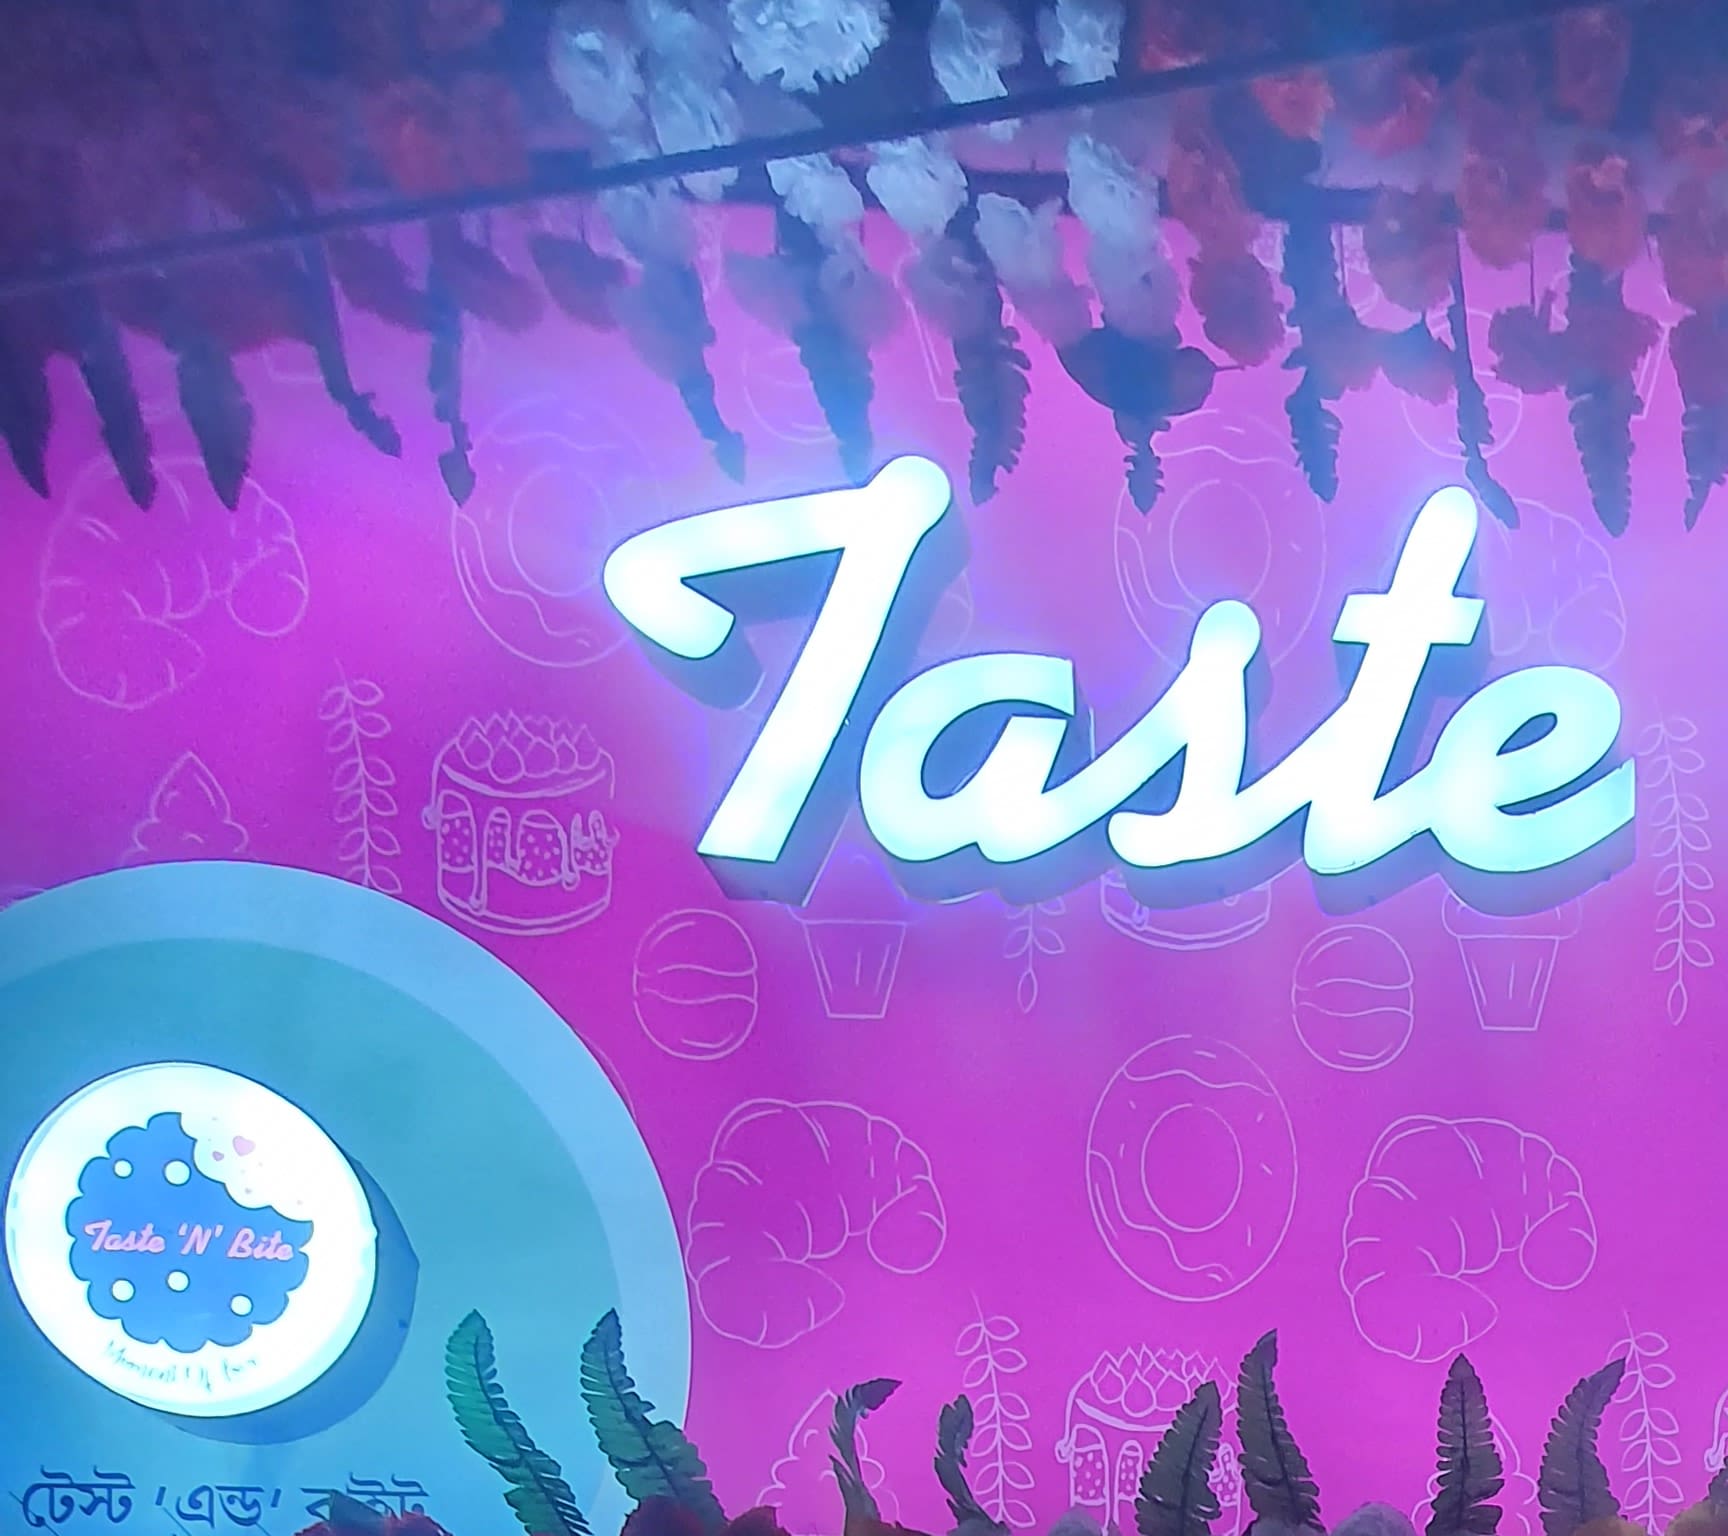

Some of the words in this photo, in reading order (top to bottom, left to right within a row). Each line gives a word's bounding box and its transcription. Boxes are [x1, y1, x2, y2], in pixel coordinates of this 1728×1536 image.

[603, 455, 1636, 874] Taste
[84, 1219, 166, 1252] Taste
[226, 1226, 295, 1261] Bite
[22, 1465, 136, 1527] টেস্ট
